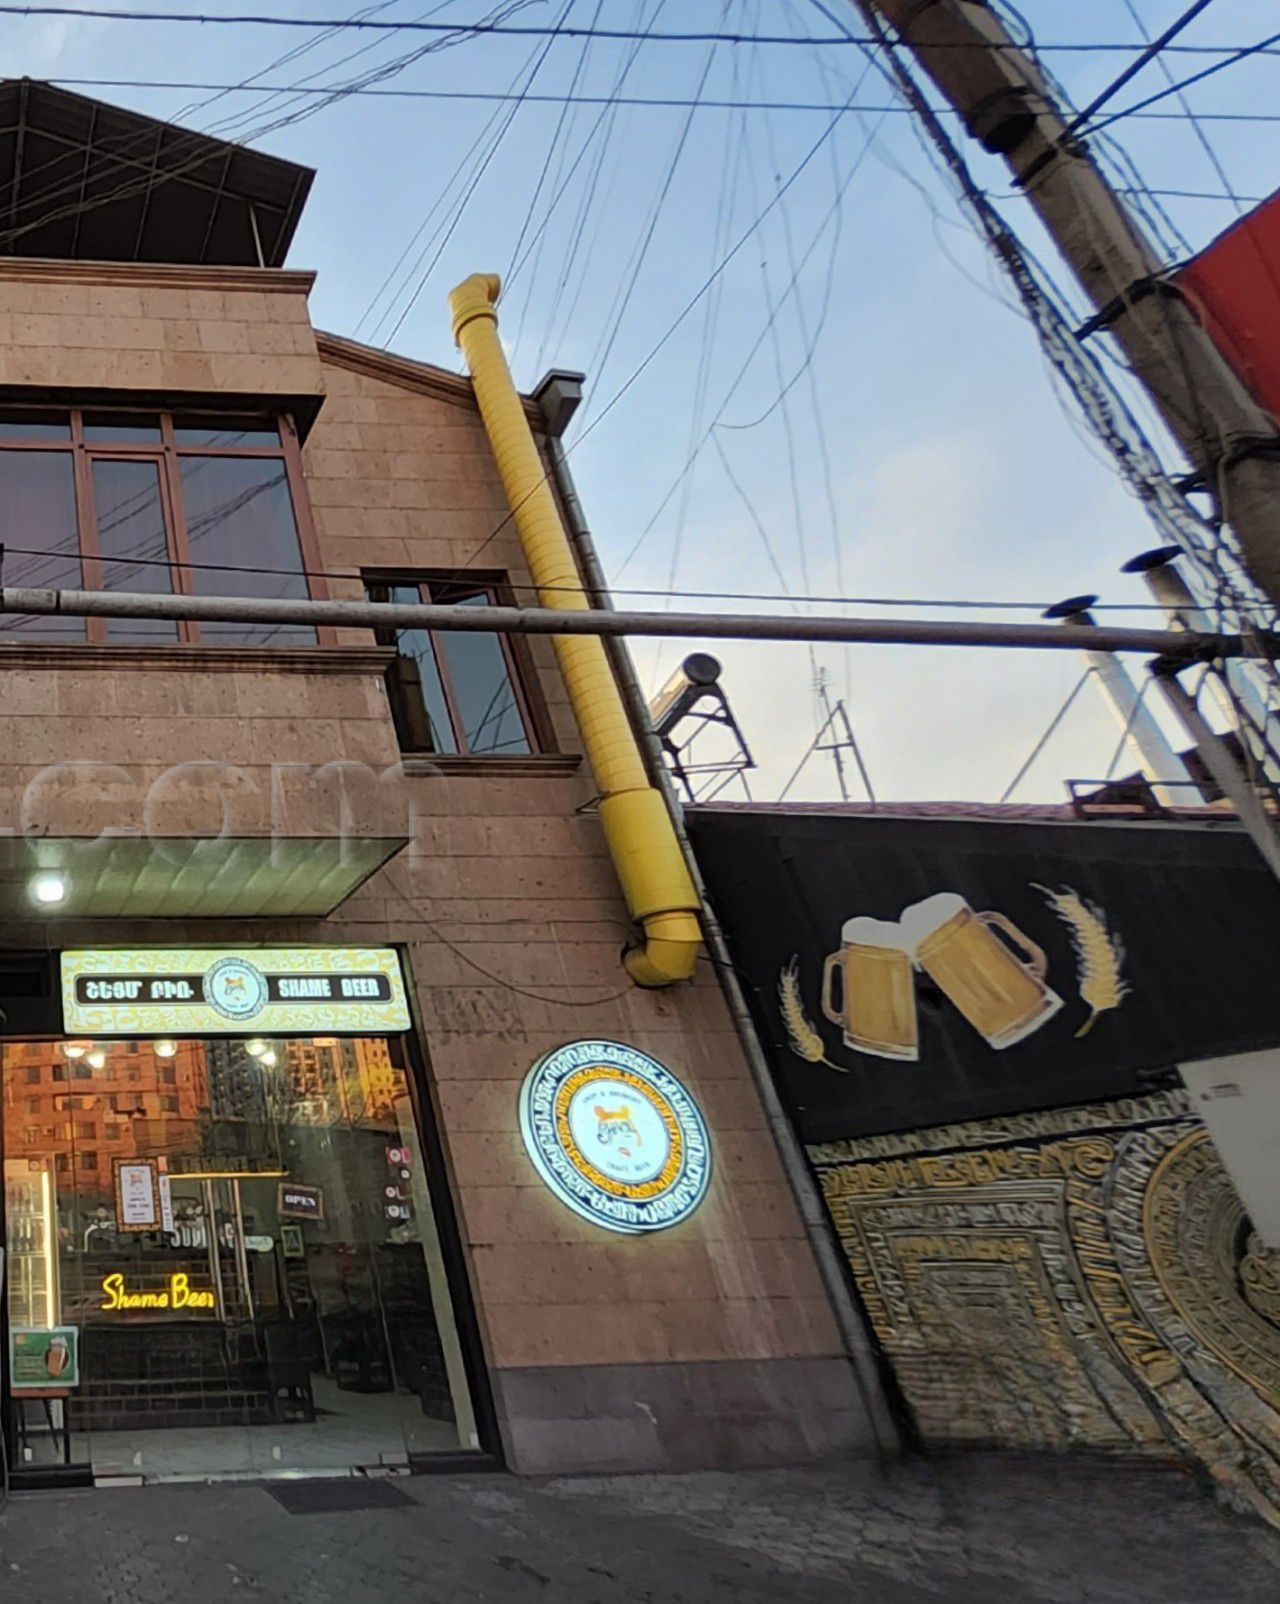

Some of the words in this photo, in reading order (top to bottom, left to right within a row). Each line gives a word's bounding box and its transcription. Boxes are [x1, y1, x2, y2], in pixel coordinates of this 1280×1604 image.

[277, 978, 332, 998] SHAME
[340, 977, 380, 997] BEER
[101, 1272, 169, 1310] Shame
